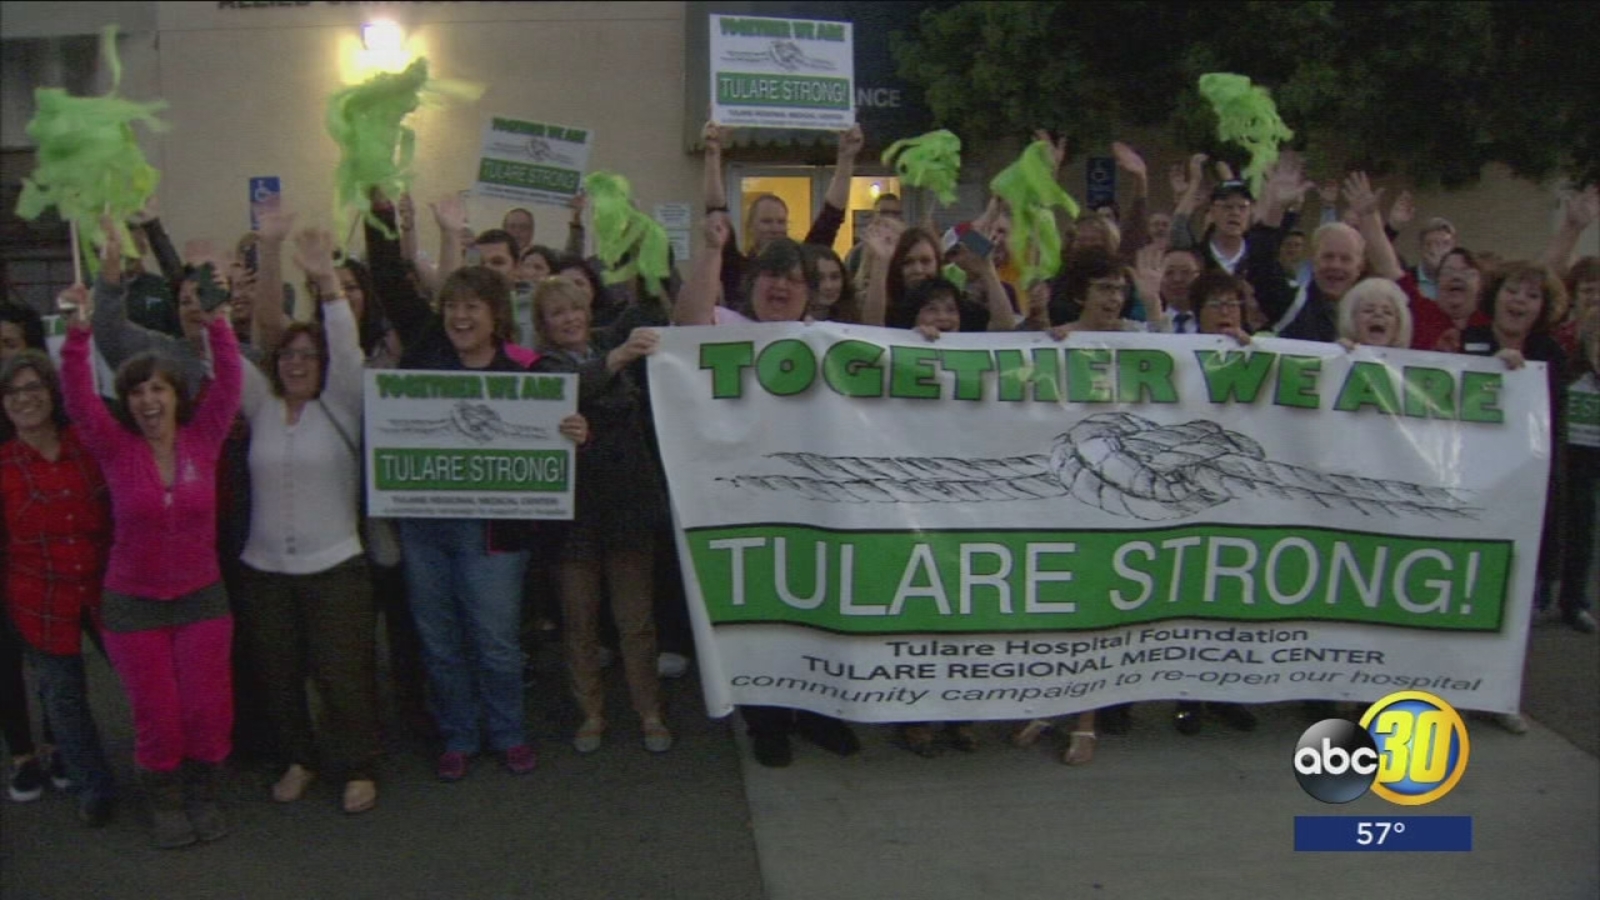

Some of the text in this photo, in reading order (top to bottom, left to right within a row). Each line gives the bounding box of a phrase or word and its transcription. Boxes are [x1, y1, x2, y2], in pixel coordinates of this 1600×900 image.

[720, 77, 847, 102] TULARE STRONG!
[857, 87, 901, 108] NCE
[699, 339, 1180, 403] TOGETHER
[1194, 350, 1322, 409] WE
[1332, 361, 1505, 424] ARE
[380, 455, 565, 483] TULARE STRONG!
[709, 536, 1481, 616] TULARE STRONG!
[886, 627, 1309, 657] Tulare Hospital Foundation
[803, 646, 1386, 680] TULARE REGIONAL MEDICAL CENTER
[731, 667, 1482, 706] community campaign to re-open our hospital
